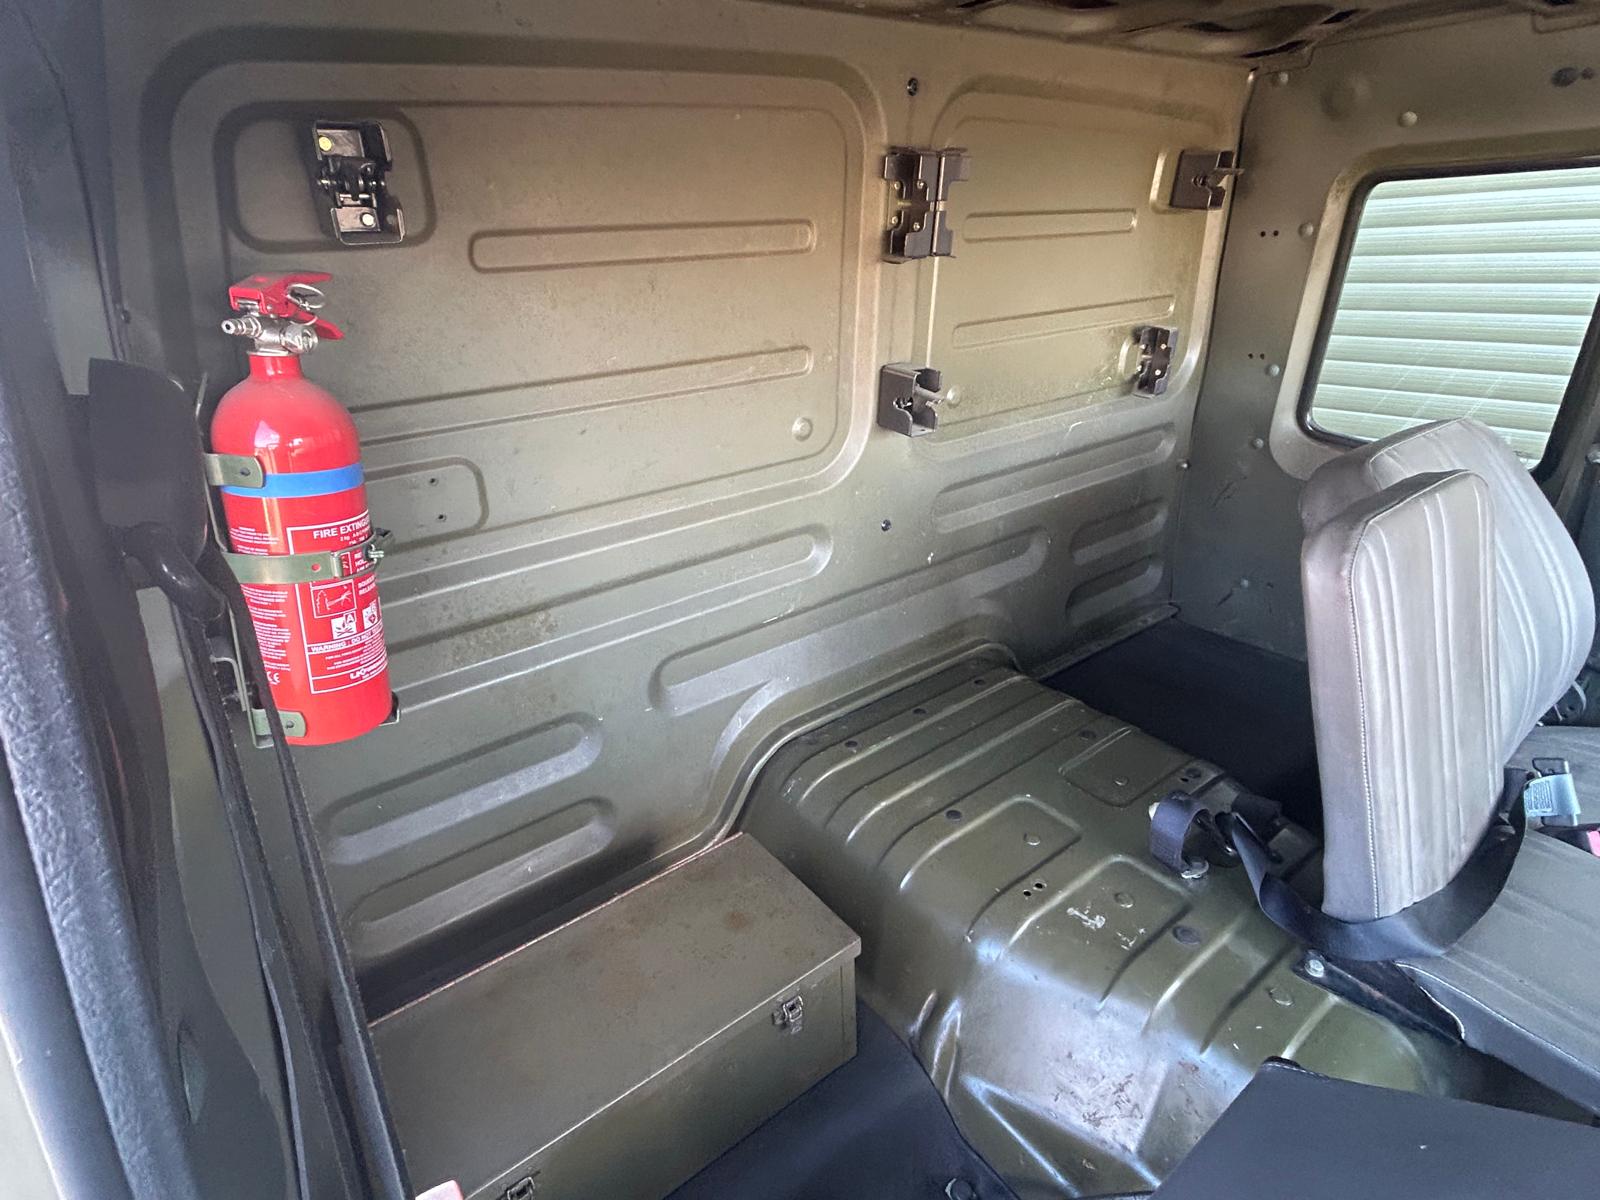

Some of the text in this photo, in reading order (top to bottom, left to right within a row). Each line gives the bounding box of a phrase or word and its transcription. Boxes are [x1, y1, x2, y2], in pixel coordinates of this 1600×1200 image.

[313, 527, 338, 540] FIRE
[347, 613, 355, 624] A
[311, 640, 347, 653] WARNING
[351, 635, 361, 645] DO
